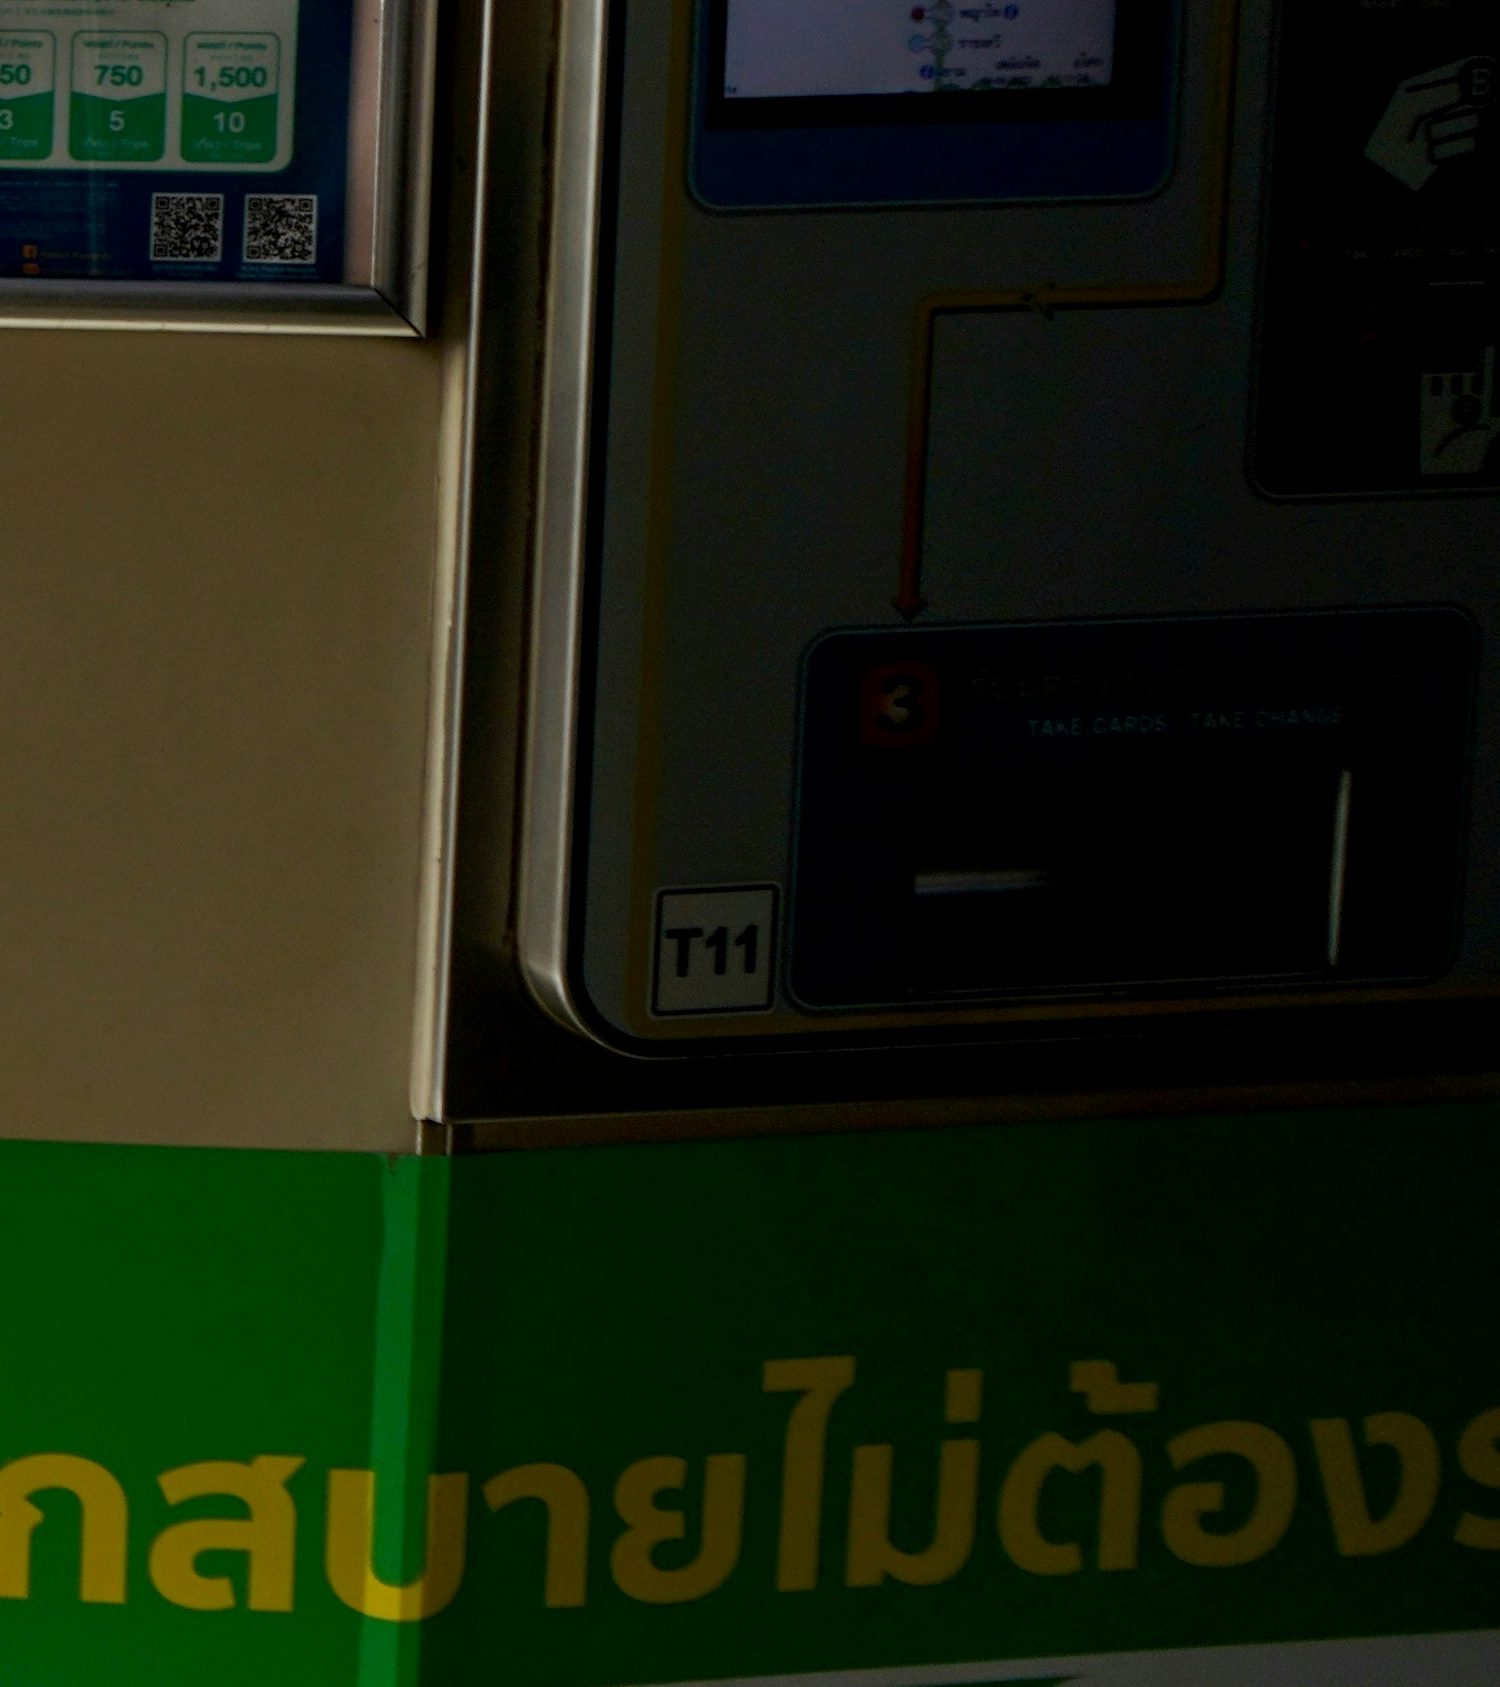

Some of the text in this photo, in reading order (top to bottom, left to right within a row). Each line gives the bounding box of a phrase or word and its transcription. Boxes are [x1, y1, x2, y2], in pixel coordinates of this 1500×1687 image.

[94, 64, 144, 86] 750
[195, 66, 267, 90] 1,500
[663, 922, 763, 980] T11
